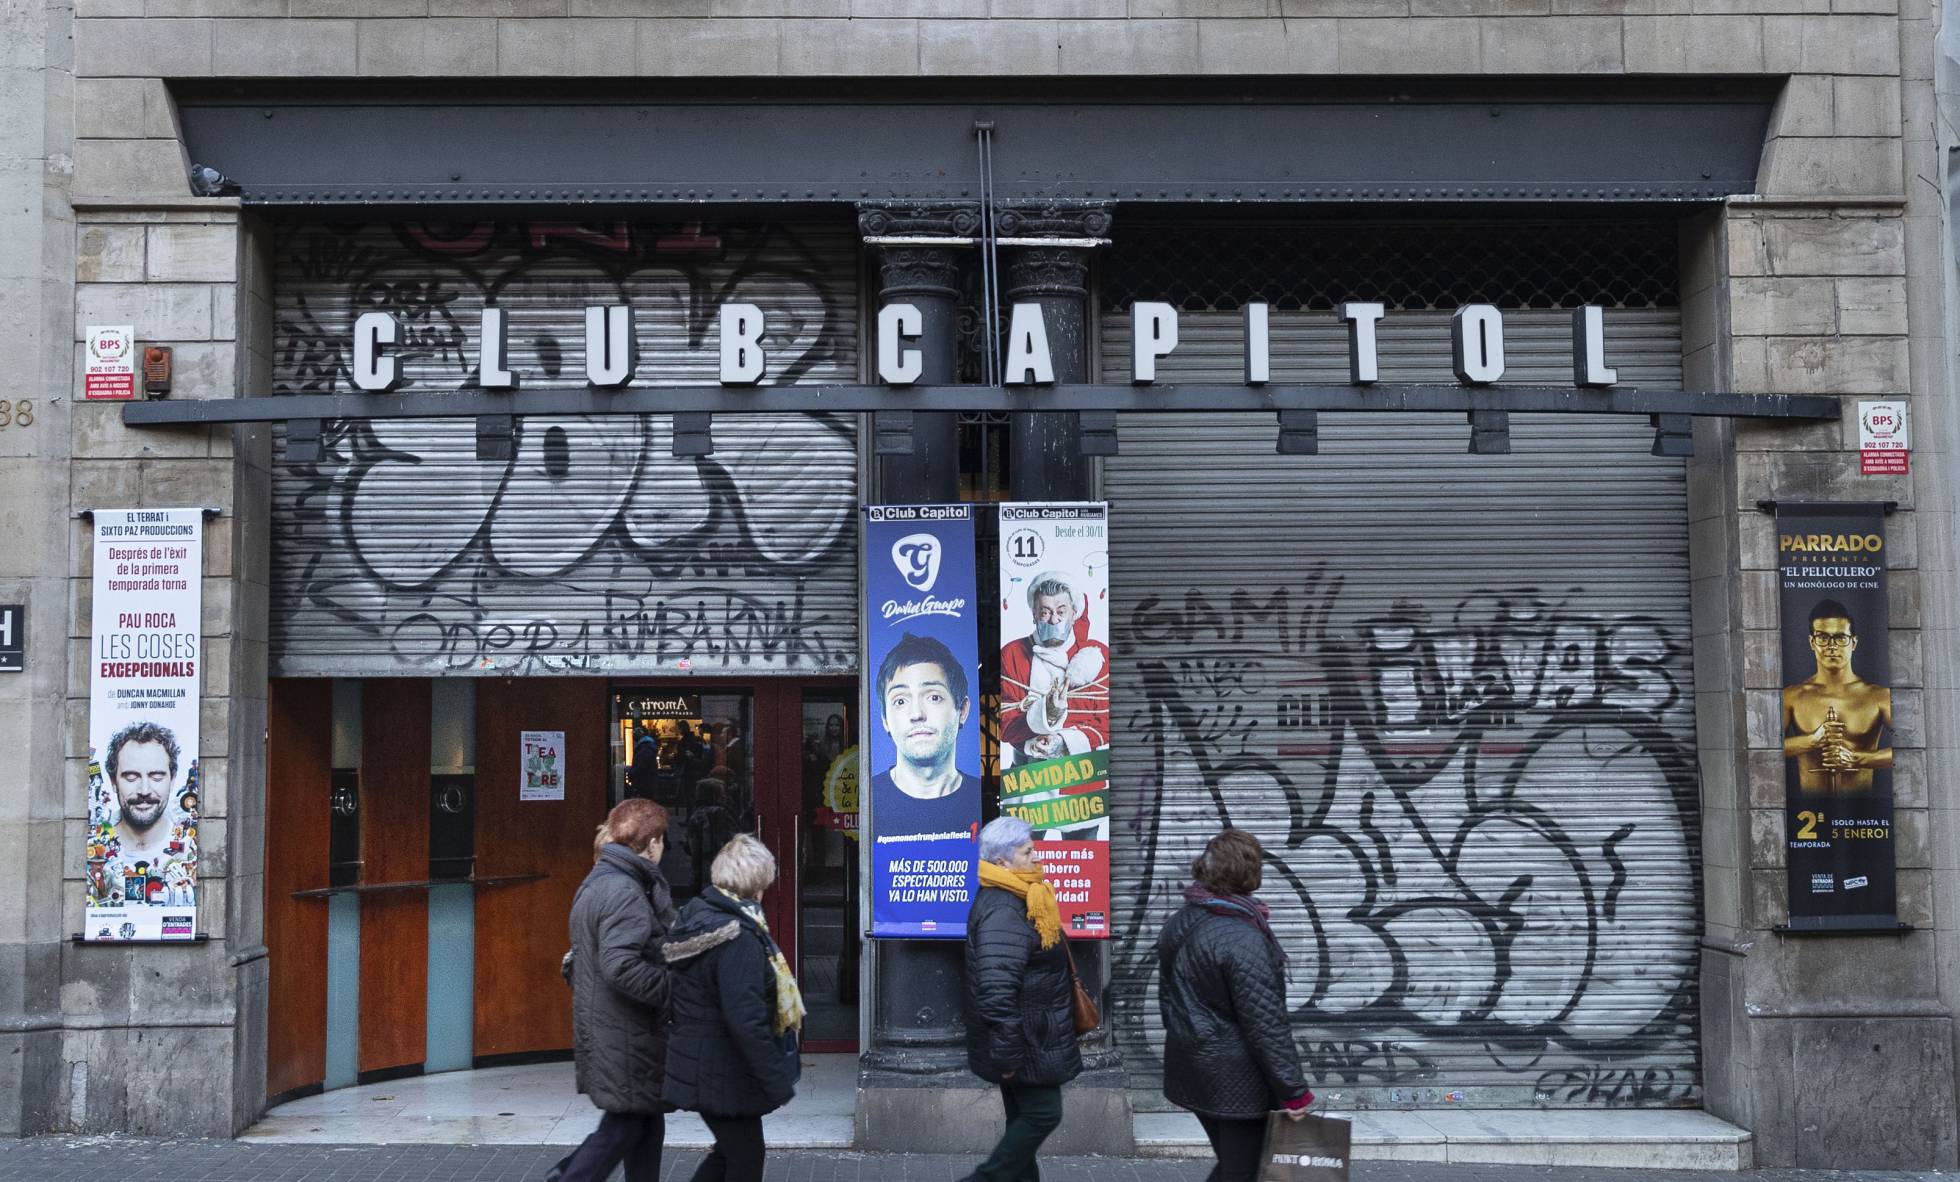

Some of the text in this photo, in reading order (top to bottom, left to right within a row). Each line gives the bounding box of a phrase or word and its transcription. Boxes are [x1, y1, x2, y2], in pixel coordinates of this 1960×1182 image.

[100, 339, 120, 350] BPS
[353, 303, 769, 392] CLUB
[877, 301, 1618, 386] CAPITOL
[1872, 415, 1893, 425] BPS
[1864, 441, 1904, 449] 902 107 720
[127, 512, 134, 522] EL
[137, 512, 164, 522] TERRAT
[885, 507, 916, 518] Club
[919, 506, 967, 520] Capitol
[1015, 508, 1039, 518] Club
[1041, 508, 1078, 519] Capitol
[101, 525, 194, 536] SIXTO PAZ PRODUCCIONS
[1055, 525, 1076, 538] Desde
[1077, 525, 1084, 538] el
[1085, 525, 1104, 538] 30/11
[1014, 536, 1038, 558] 11
[1780, 534, 1883, 552] PARRADO
[109, 547, 148, 561] Després
[150, 547, 162, 559] de
[117, 563, 179, 576] de la primera
[109, 578, 187, 592] temporada torna
[1797, 580, 1845, 589] MONÓLOGO
[881, 595, 965, 619] David Guapo
[119, 612, 176, 628] PAU ROCA
[101, 633, 195, 659] LES COSES
[100, 662, 194, 678] EXCEPCIONALS
[117, 688, 145, 698] DUNCAN
[146, 688, 186, 698] MACMILLAN
[130, 701, 148, 709] JONNY
[149, 700, 176, 709] DONAHOE
[1002, 758, 1095, 794] NAVIDAD
[1006, 796, 1105, 826] TONI MOOG
[843, 814, 859, 829] CLU
[1831, 828, 1889, 839] 5 ENERO!
[1070, 848, 1094, 860] más
[889, 858, 968, 873] MÁS DE 500.000
[892, 875, 965, 888] ESPECTADORES
[1053, 879, 1060, 888] a
[1063, 879, 1091, 888] casa
[888, 889, 970, 902] YA LO HAN VISTO.
